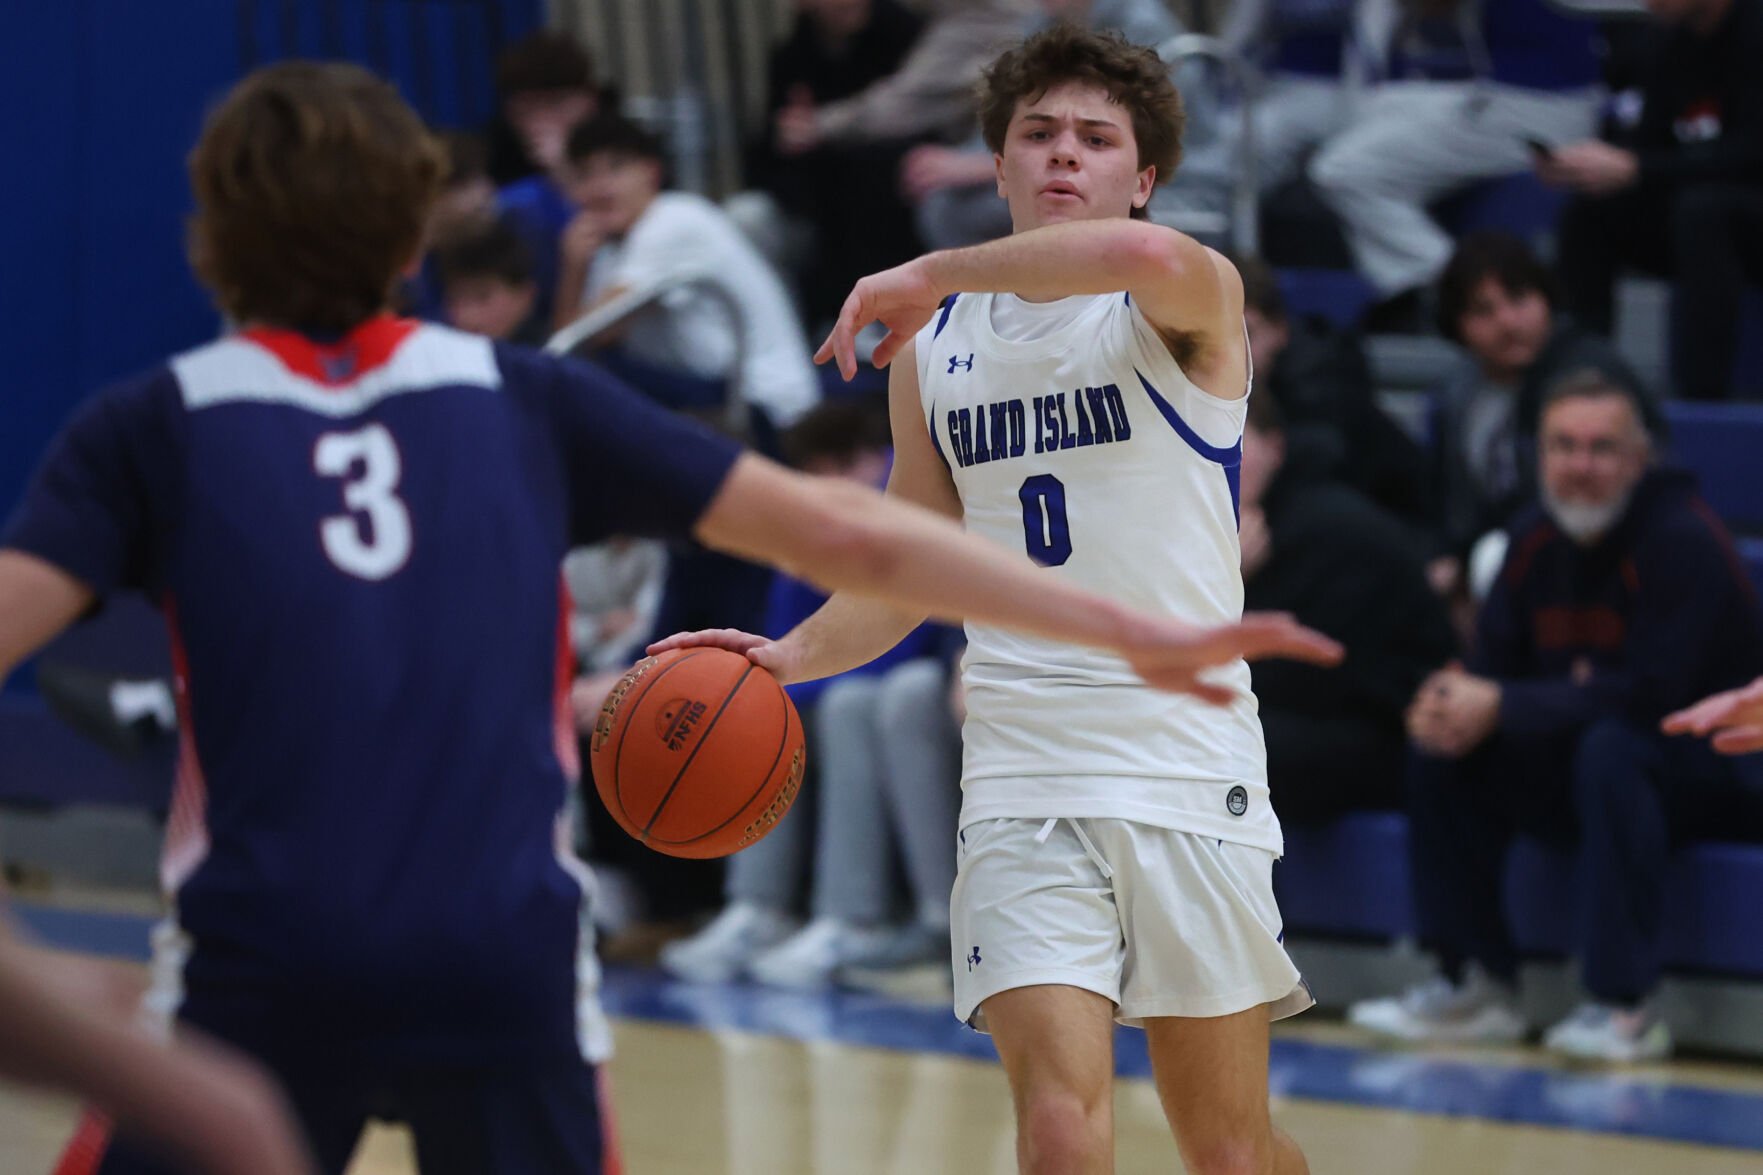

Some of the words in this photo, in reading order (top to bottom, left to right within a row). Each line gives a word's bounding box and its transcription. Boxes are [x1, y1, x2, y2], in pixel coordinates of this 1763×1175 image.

[947, 398, 1026, 468] GRAND
[1032, 383, 1131, 454] ISLAND
[312, 422, 412, 582] 3
[1018, 473, 1073, 568] 0
[674, 701, 707, 741] NFHS
